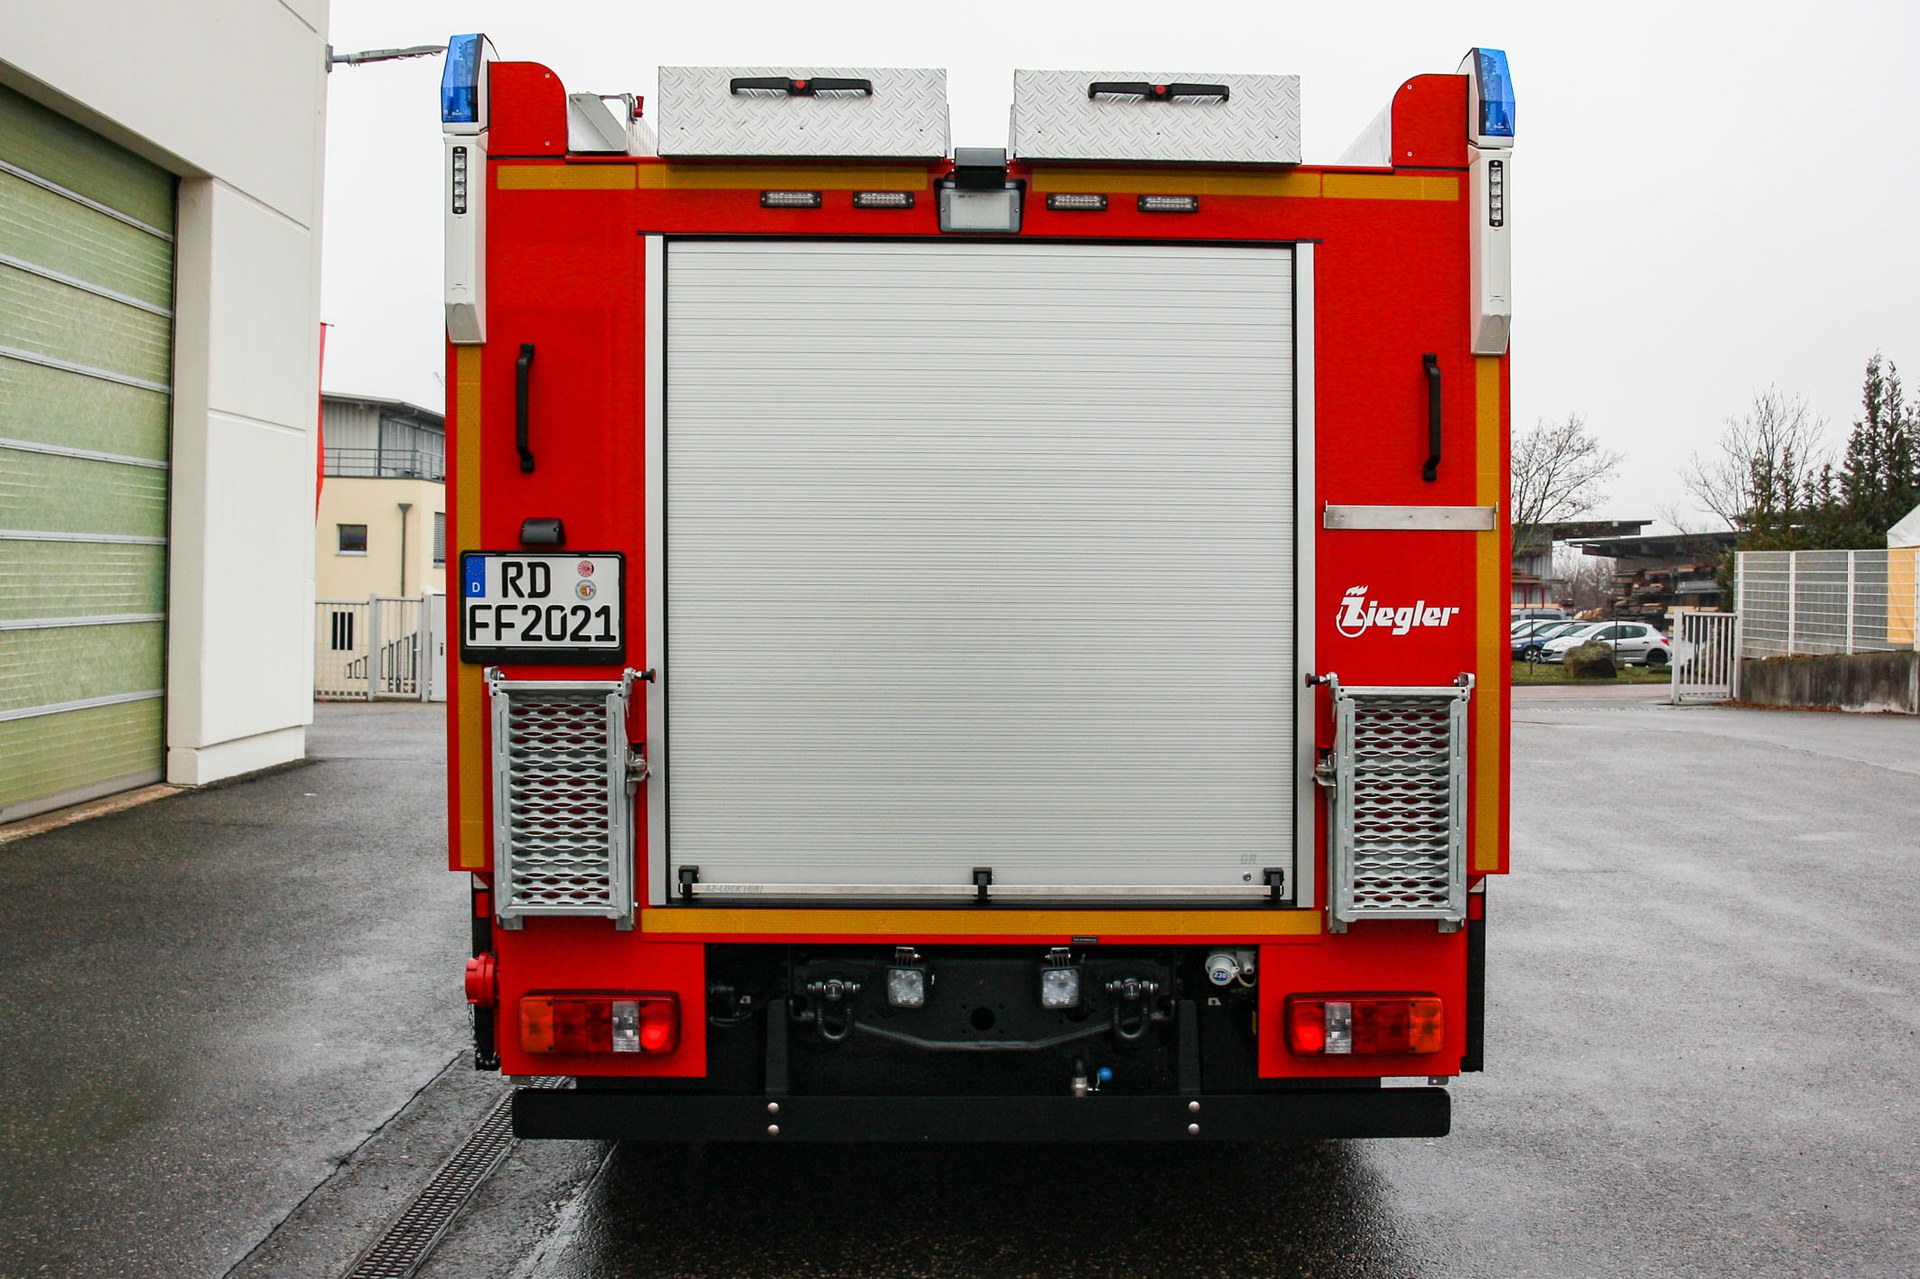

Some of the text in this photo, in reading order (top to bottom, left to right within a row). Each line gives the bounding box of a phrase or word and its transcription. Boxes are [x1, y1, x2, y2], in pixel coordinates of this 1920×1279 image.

[472, 581, 481, 593] D
[501, 561, 551, 598] RD
[469, 604, 617, 642] FF2021
[1336, 590, 1460, 637] Ziegler
